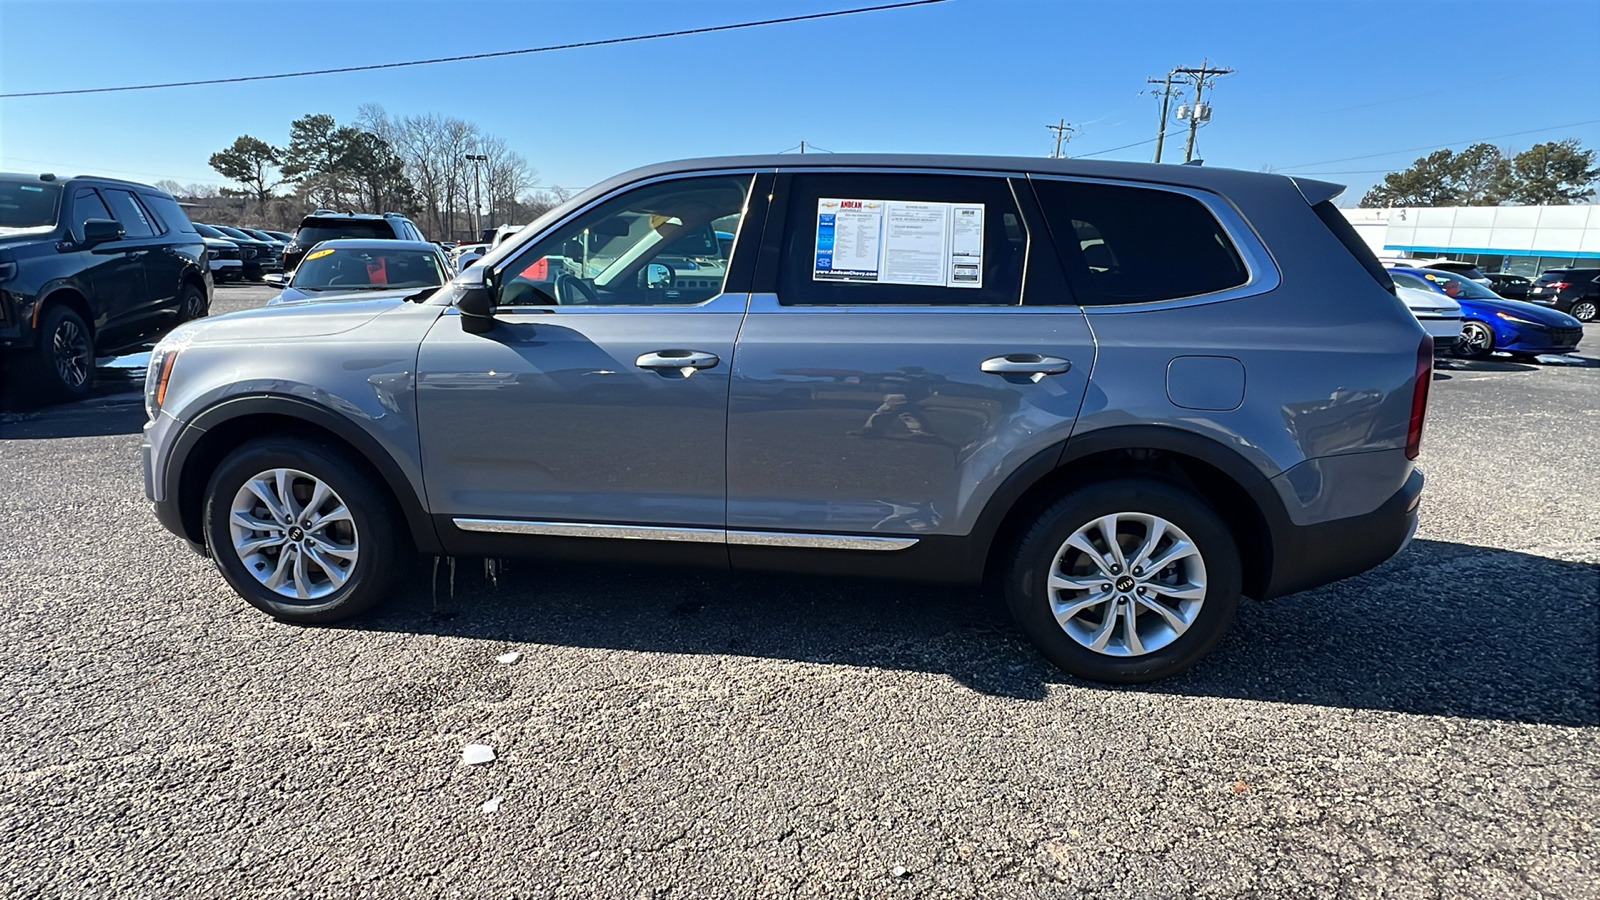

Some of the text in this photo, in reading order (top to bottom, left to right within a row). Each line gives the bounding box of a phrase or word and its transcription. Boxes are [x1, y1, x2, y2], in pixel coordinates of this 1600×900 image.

[816, 269, 878, 277] www.AndeanChevy.com
[290, 528, 301, 540] KIA
[1117, 579, 1133, 590] KIA
